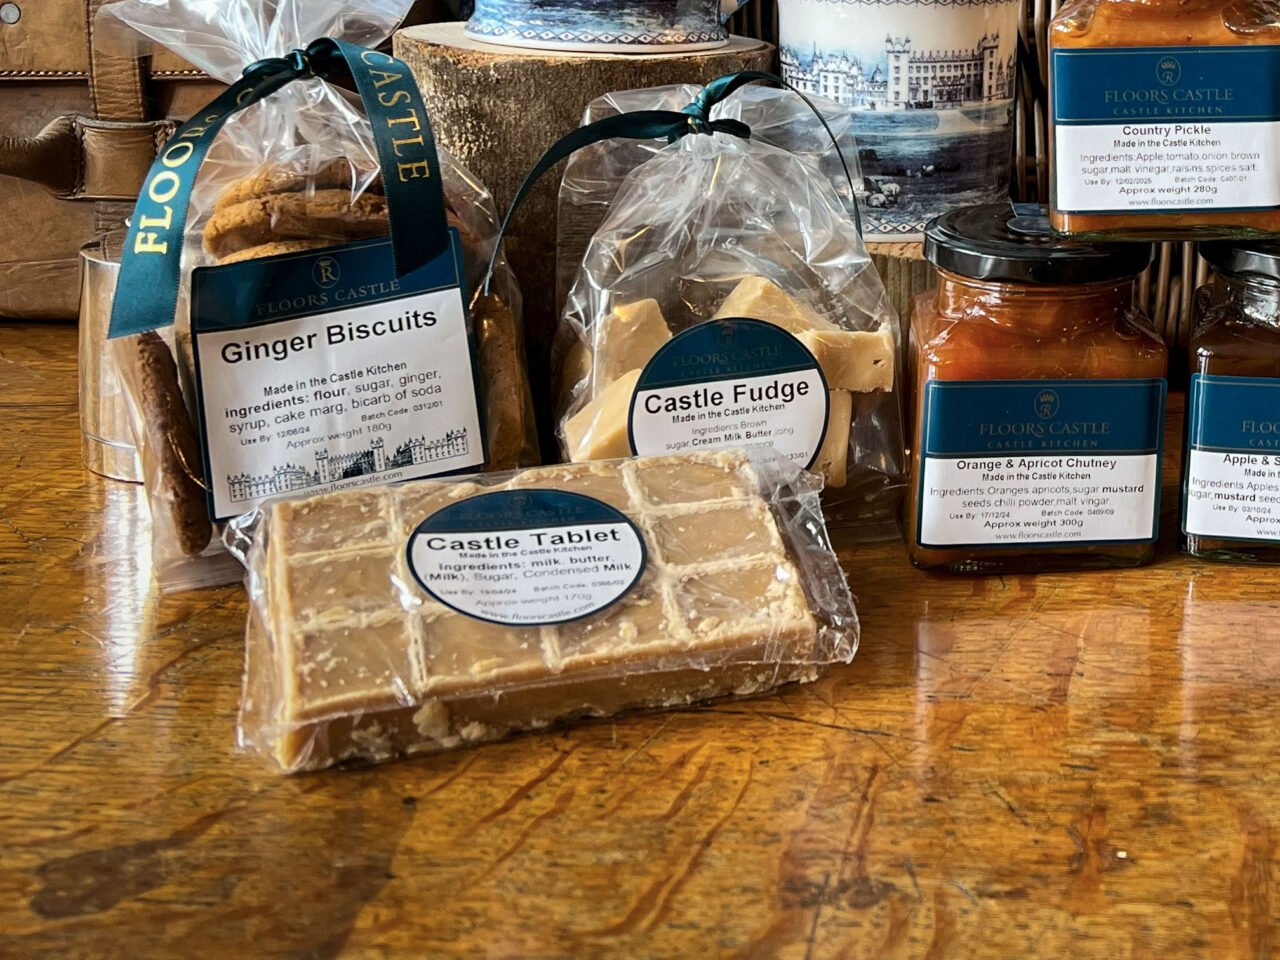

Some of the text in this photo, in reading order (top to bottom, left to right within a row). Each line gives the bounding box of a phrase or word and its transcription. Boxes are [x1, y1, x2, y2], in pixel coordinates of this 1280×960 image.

[1104, 88, 1233, 104] FLOORS CASTLE
[361, 51, 430, 183] CASTLE
[1114, 106, 1223, 116] CASTLE KITCHEN
[1122, 125, 1212, 137] Country Pickle
[1162, 139, 1187, 147] Castle
[1190, 139, 1221, 147] Kitchen
[1119, 185, 1218, 195] Approx weight 280g
[1129, 197, 1213, 207] www.floorscastle.com
[256, 278, 401, 316] FLOORS CASTLE
[221, 309, 438, 364] Ginger Biscuits
[673, 353, 729, 368] FLOORS
[264, 361, 408, 397] Made in the Castle Kitchen
[274, 408, 305, 424] cake
[351, 393, 391, 409] bicarb
[395, 388, 408, 401] of
[411, 383, 442, 398] soda
[645, 380, 809, 414] Castle Fudge
[225, 394, 310, 419] ingredients:
[672, 413, 696, 423] Made
[708, 410, 722, 419] the
[724, 407, 750, 417] Castle
[752, 403, 785, 413] Kitchen
[286, 422, 392, 450] Approx weight 180g
[979, 422, 1111, 438] FLOORS CASTLE
[1041, 440, 1098, 448] KITCHEN
[957, 459, 1117, 471] Orange & Apricot Chutney
[1223, 454, 1258, 466] Apple
[1262, 456, 1270, 465] &
[982, 473, 1005, 481] Made
[1032, 472, 1057, 480] Castle
[1059, 472, 1091, 480] Kitchen
[984, 519, 1084, 529] Approx weight 300g
[1245, 515, 1280, 525] Approx
[427, 528, 621, 551] Castle Tablet
[995, 531, 1081, 540] www.floorscastle.com
[439, 560, 526, 572] Ingredients:
[523, 566, 599, 578] Condensed
[603, 562, 632, 572] Milk
